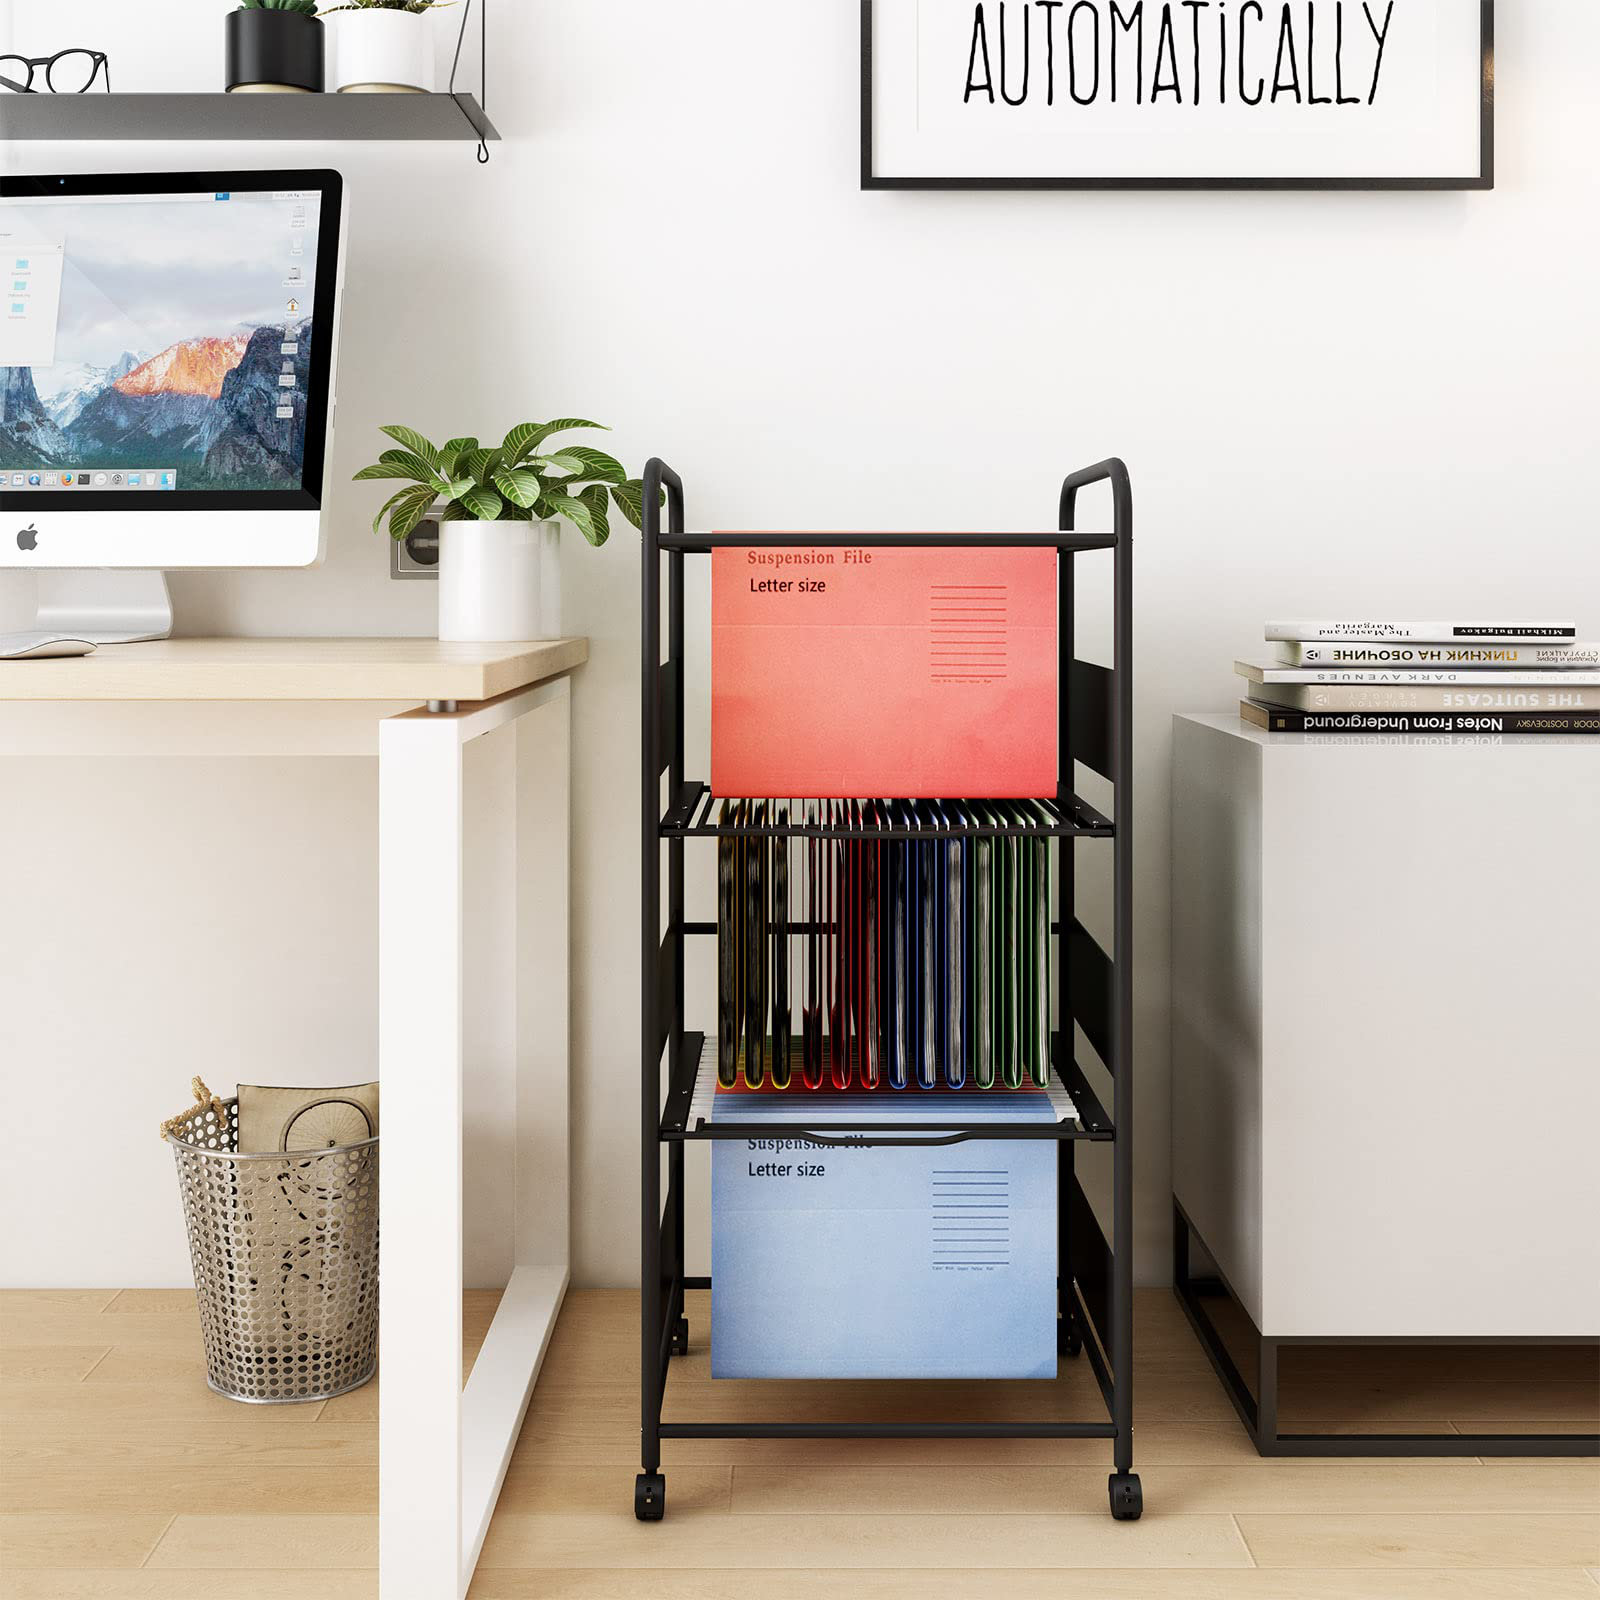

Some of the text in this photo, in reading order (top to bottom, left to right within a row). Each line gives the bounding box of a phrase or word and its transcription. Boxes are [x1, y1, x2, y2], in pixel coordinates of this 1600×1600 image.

[747, 549, 872, 568] Suspension File
[750, 577, 826, 592] Letter size
[1333, 650, 1518, 661] ПИКНИК НА ОБОЧИНЕ
[1443, 693, 1584, 707] THE SUITCASE
[1303, 715, 1503, 731] Notes From Underground
[1516, 719, 1569, 728] DOSTOEVSKY
[747, 1138, 835, 1154] Suspens
[748, 1161, 825, 1177] Letter size
